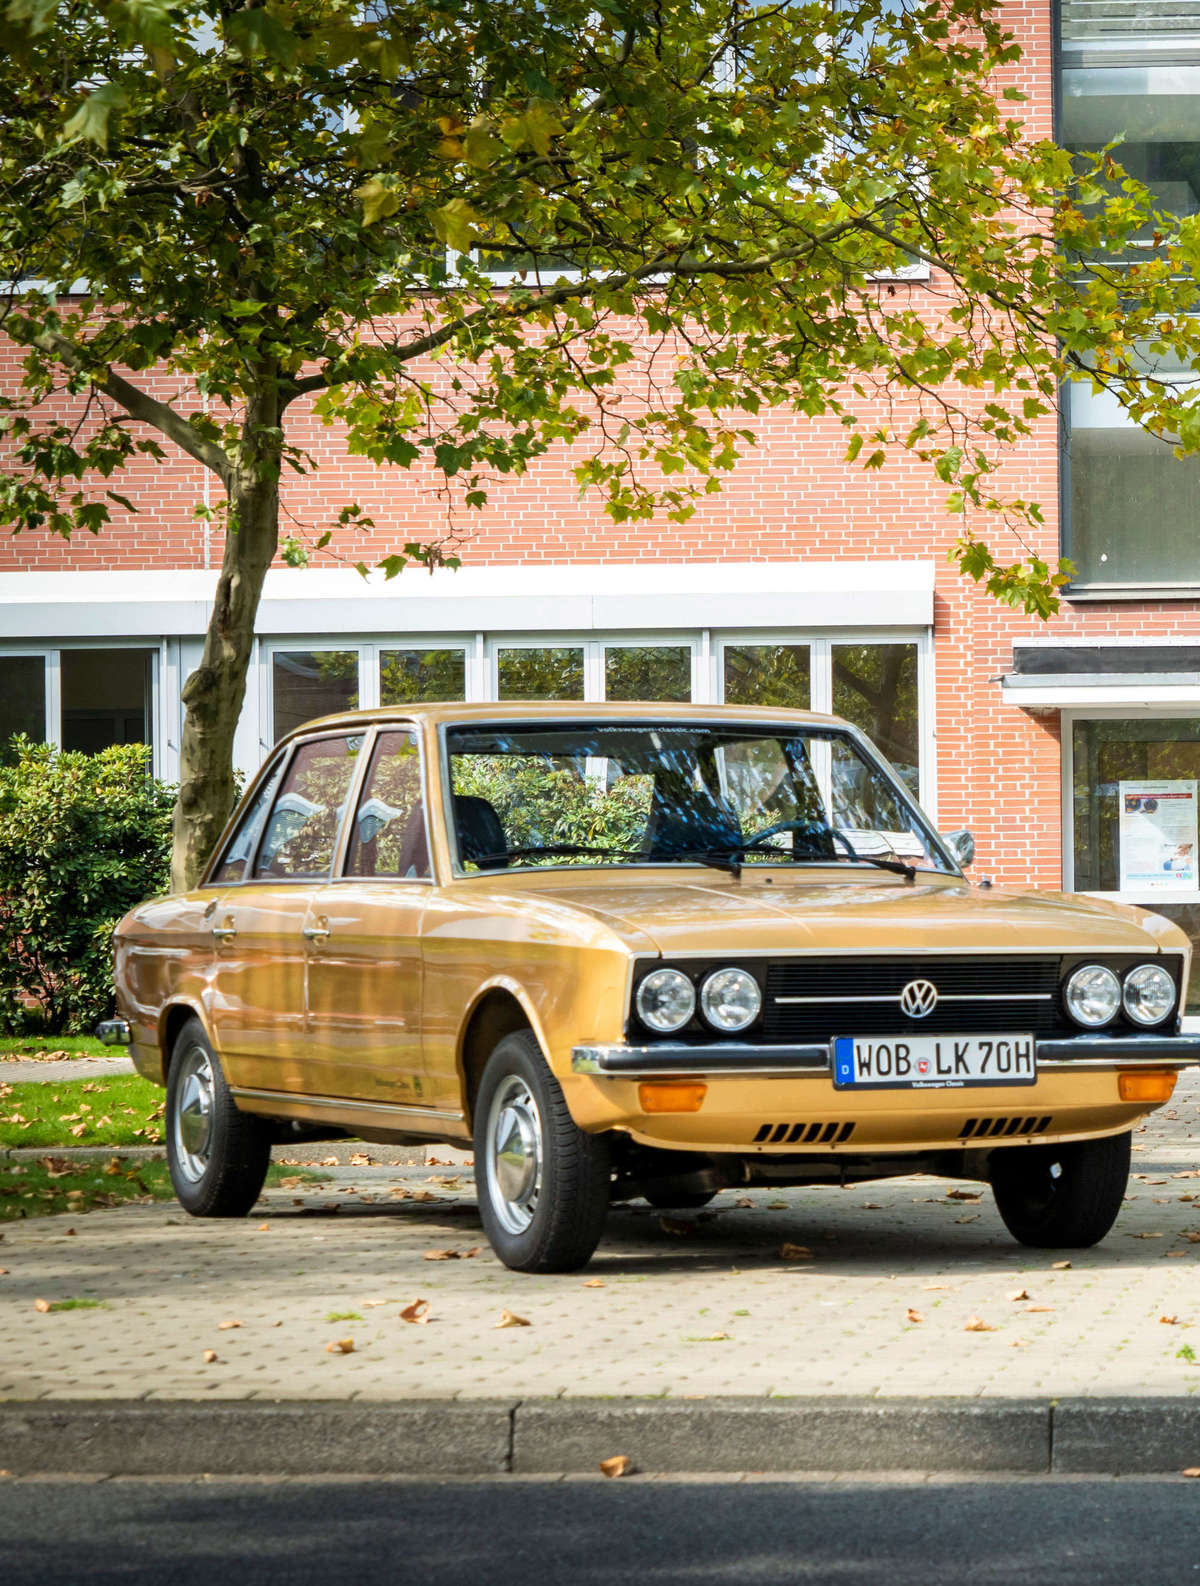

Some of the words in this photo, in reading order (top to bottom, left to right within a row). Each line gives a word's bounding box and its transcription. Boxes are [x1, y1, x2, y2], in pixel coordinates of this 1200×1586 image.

[901, 980, 937, 1018] VW
[841, 1064, 849, 1075] D
[856, 1043, 912, 1077] WOB
